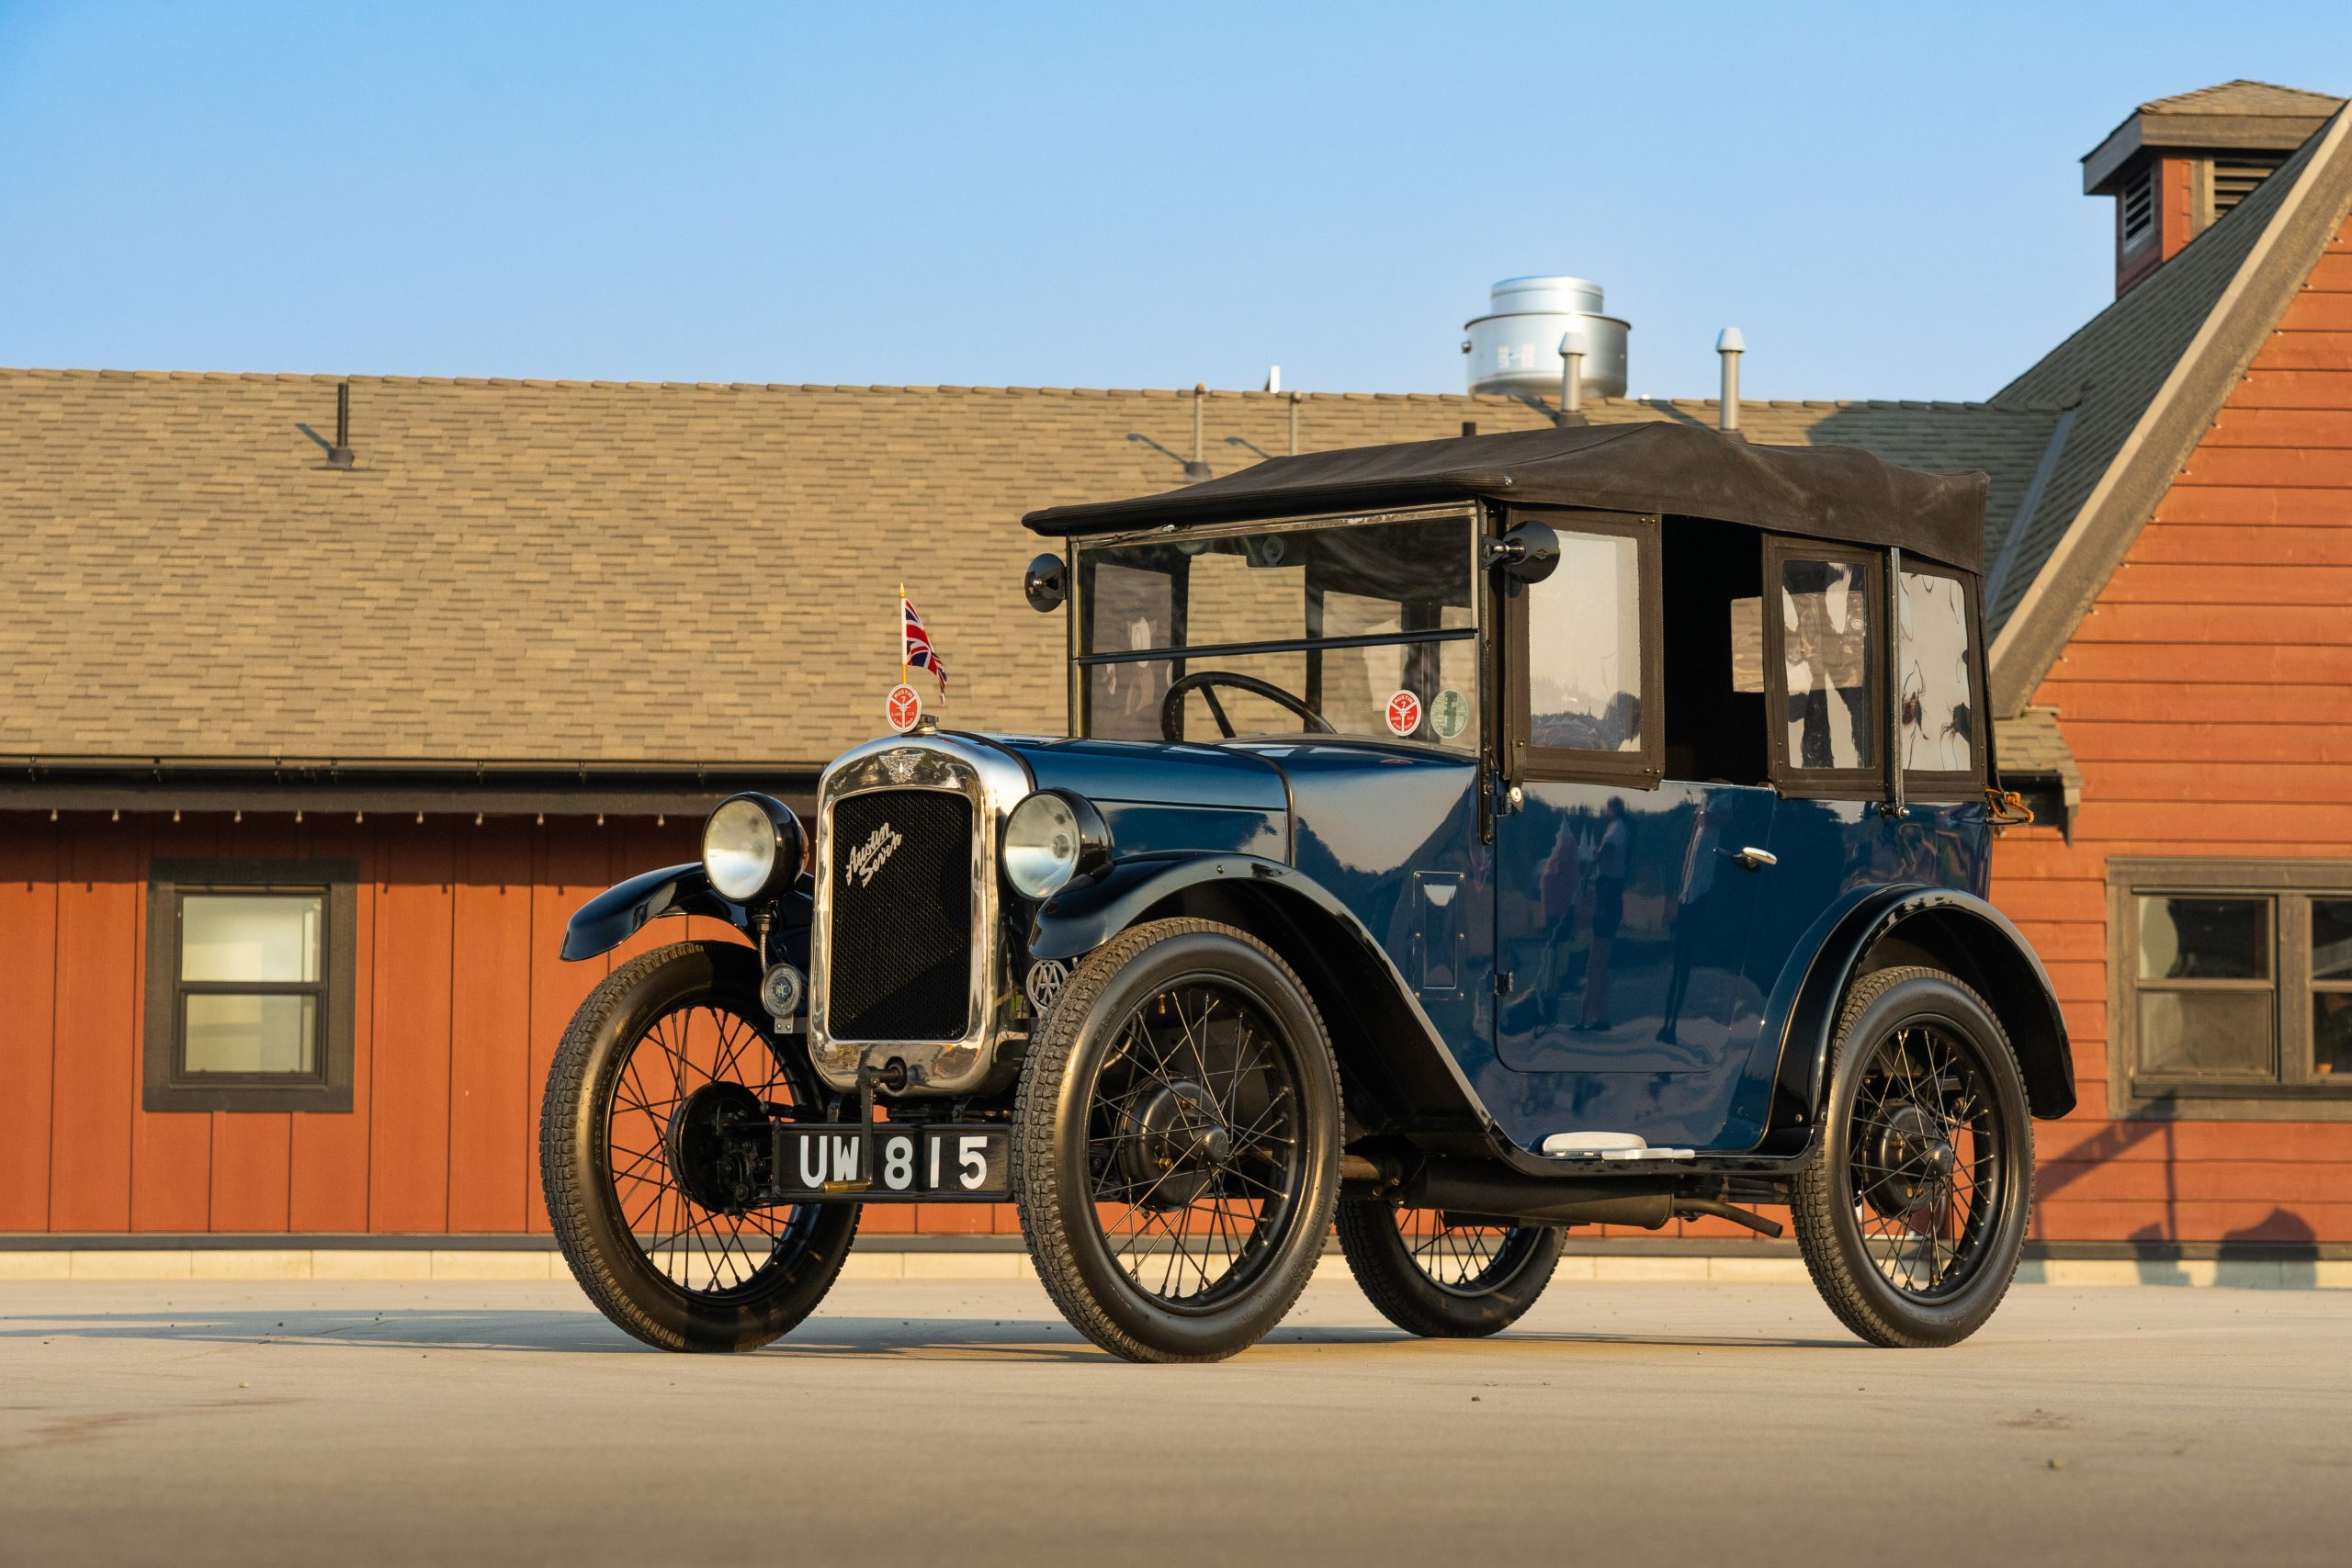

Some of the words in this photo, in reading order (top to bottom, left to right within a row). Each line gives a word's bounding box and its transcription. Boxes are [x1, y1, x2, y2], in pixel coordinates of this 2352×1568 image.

[894, 690, 914, 699] AUSTIN
[1393, 694, 1414, 704] AUSTIN
[845, 822, 889, 886] Austin
[859, 830, 903, 888] Seven
[800, 1135, 860, 1189] UW
[884, 1135, 988, 1190] 815
